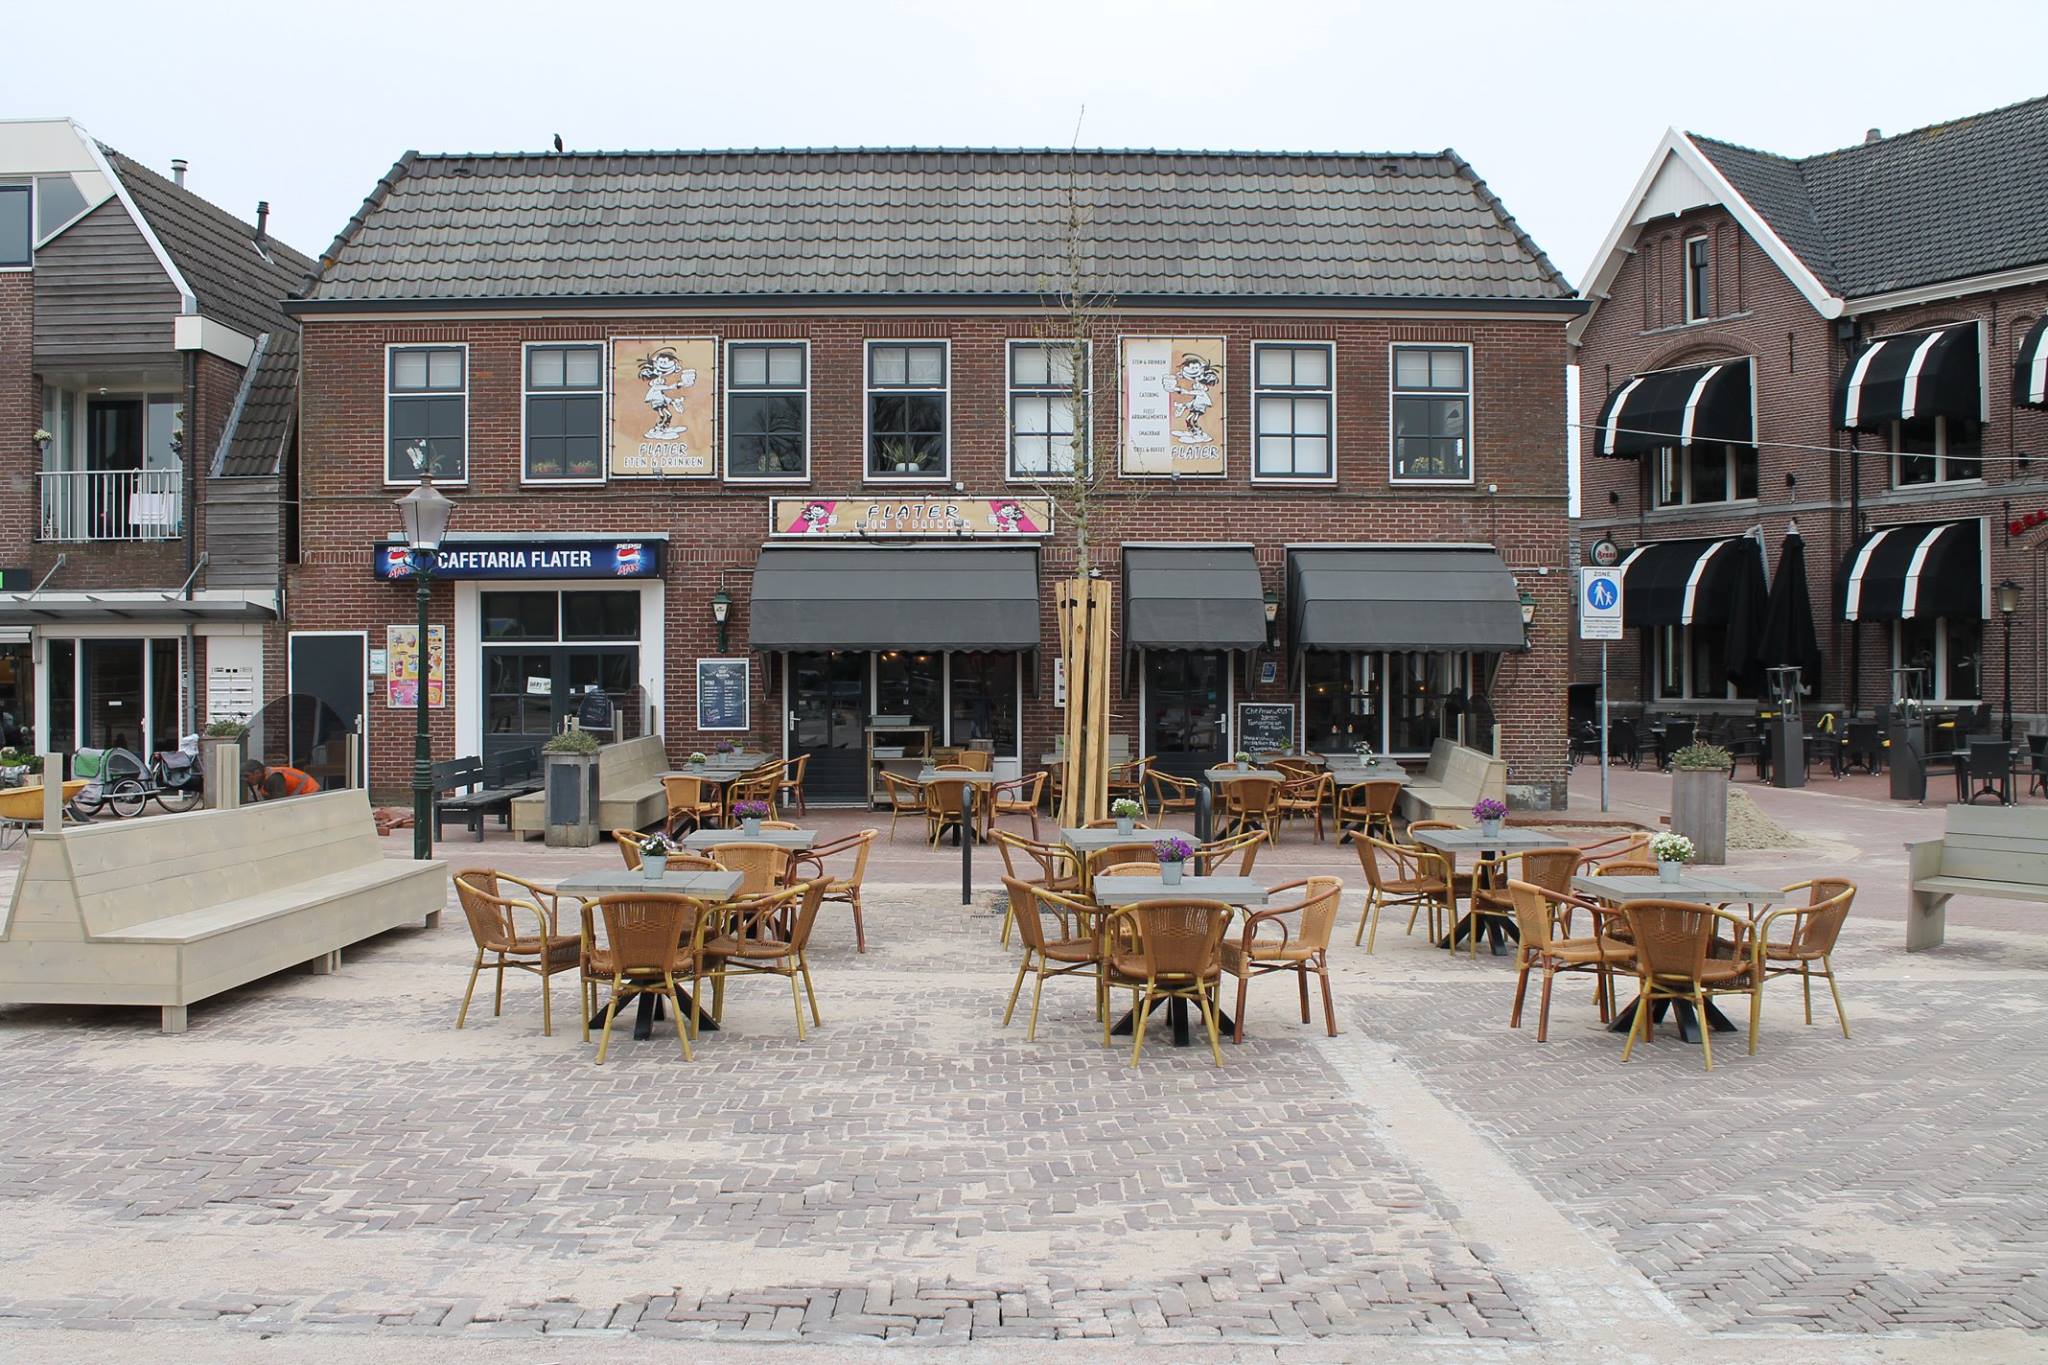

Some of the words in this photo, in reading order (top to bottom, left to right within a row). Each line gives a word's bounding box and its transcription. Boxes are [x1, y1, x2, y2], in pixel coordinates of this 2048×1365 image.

[639, 443, 689, 456] FLATER
[1171, 446, 1219, 460] FLATER
[624, 457, 647, 468] ETEN
[651, 458, 657, 468] &
[661, 457, 704, 468] DRINKEN
[867, 504, 960, 519] FLATER
[912, 519, 971, 529] DRINKN
[438, 551, 526, 569] CAFETARIA
[531, 550, 592, 568] FLATER
